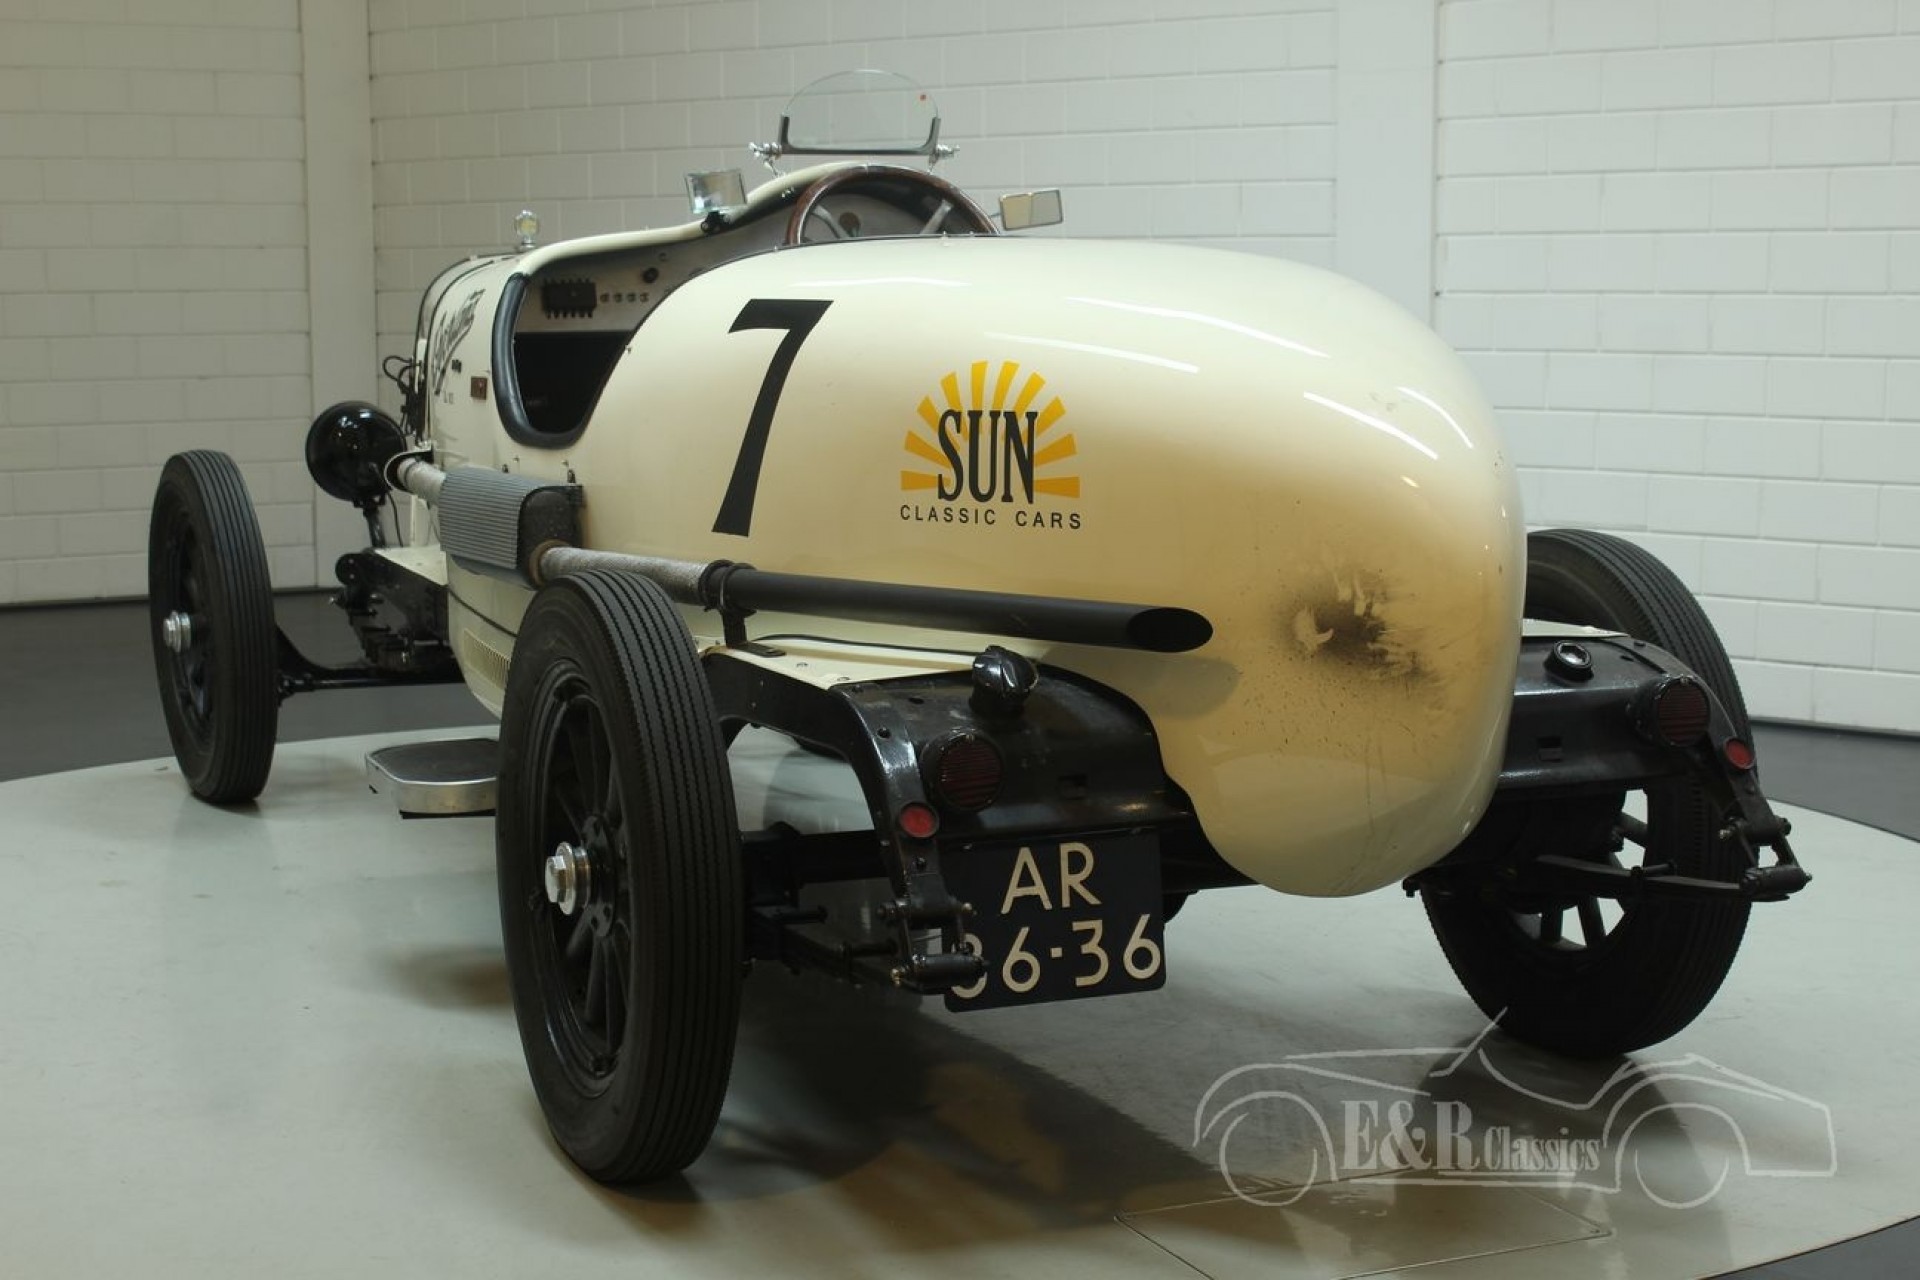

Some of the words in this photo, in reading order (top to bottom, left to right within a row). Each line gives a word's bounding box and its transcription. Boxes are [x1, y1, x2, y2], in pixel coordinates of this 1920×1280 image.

[711, 298, 835, 538] 7
[937, 409, 1038, 505] SUN
[900, 504, 996, 526] CLASSIC
[1015, 510, 1082, 530] CARS
[1001, 842, 1102, 914] AR
